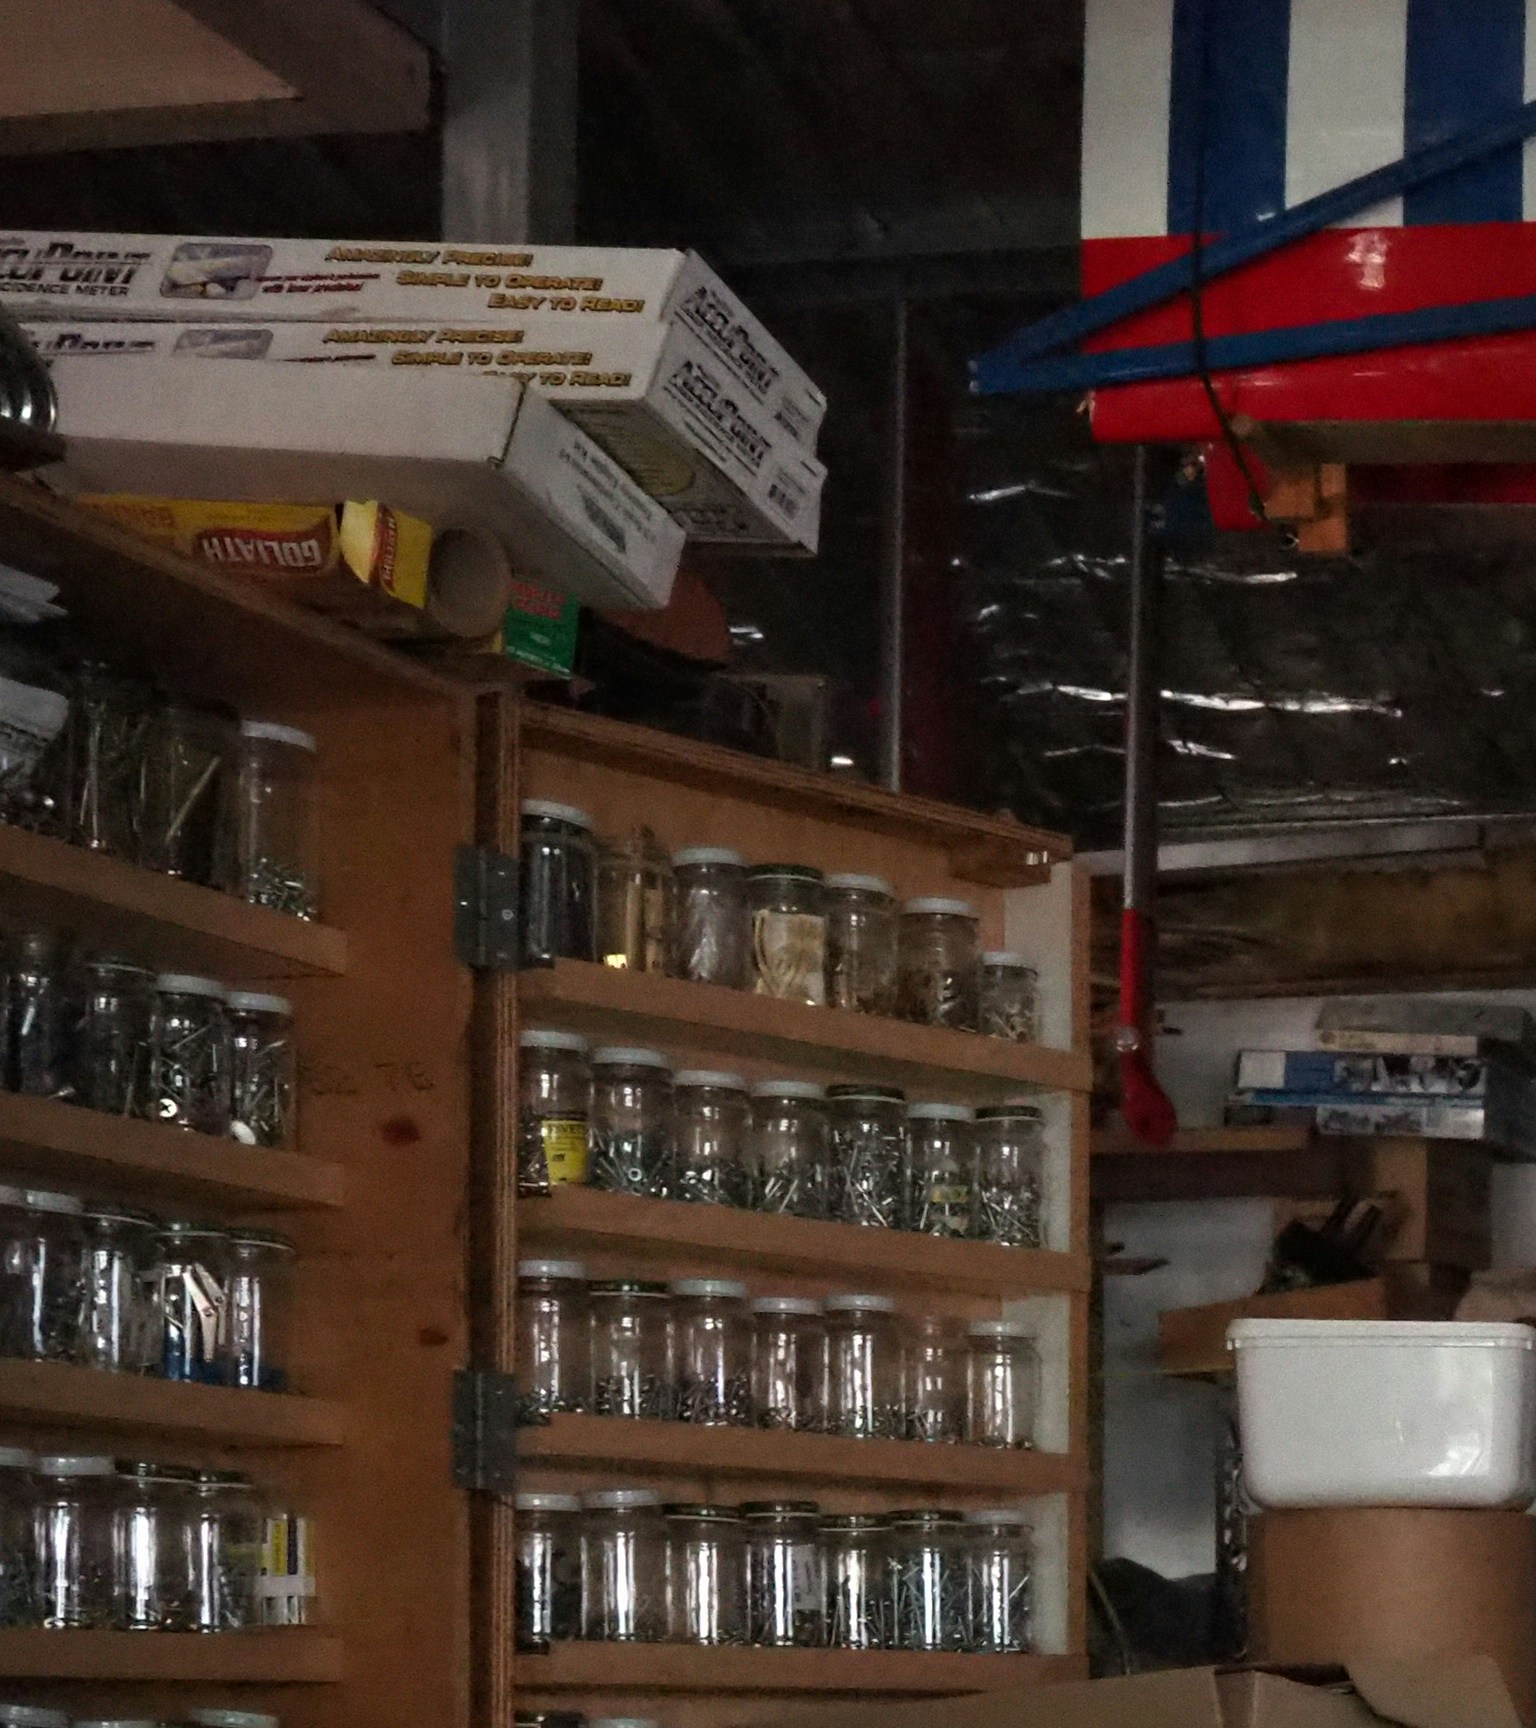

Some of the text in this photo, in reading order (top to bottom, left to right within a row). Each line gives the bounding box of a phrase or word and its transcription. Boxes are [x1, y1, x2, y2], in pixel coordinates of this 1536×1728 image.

[75, 283, 129, 297] METER
[397, 270, 469, 287] SIMPLE
[504, 273, 603, 291] OPERATE!
[488, 293, 547, 310] EASY
[581, 296, 645, 313] READ!
[569, 371, 632, 386] READ!
[203, 535, 321, 568] GOLIATH
